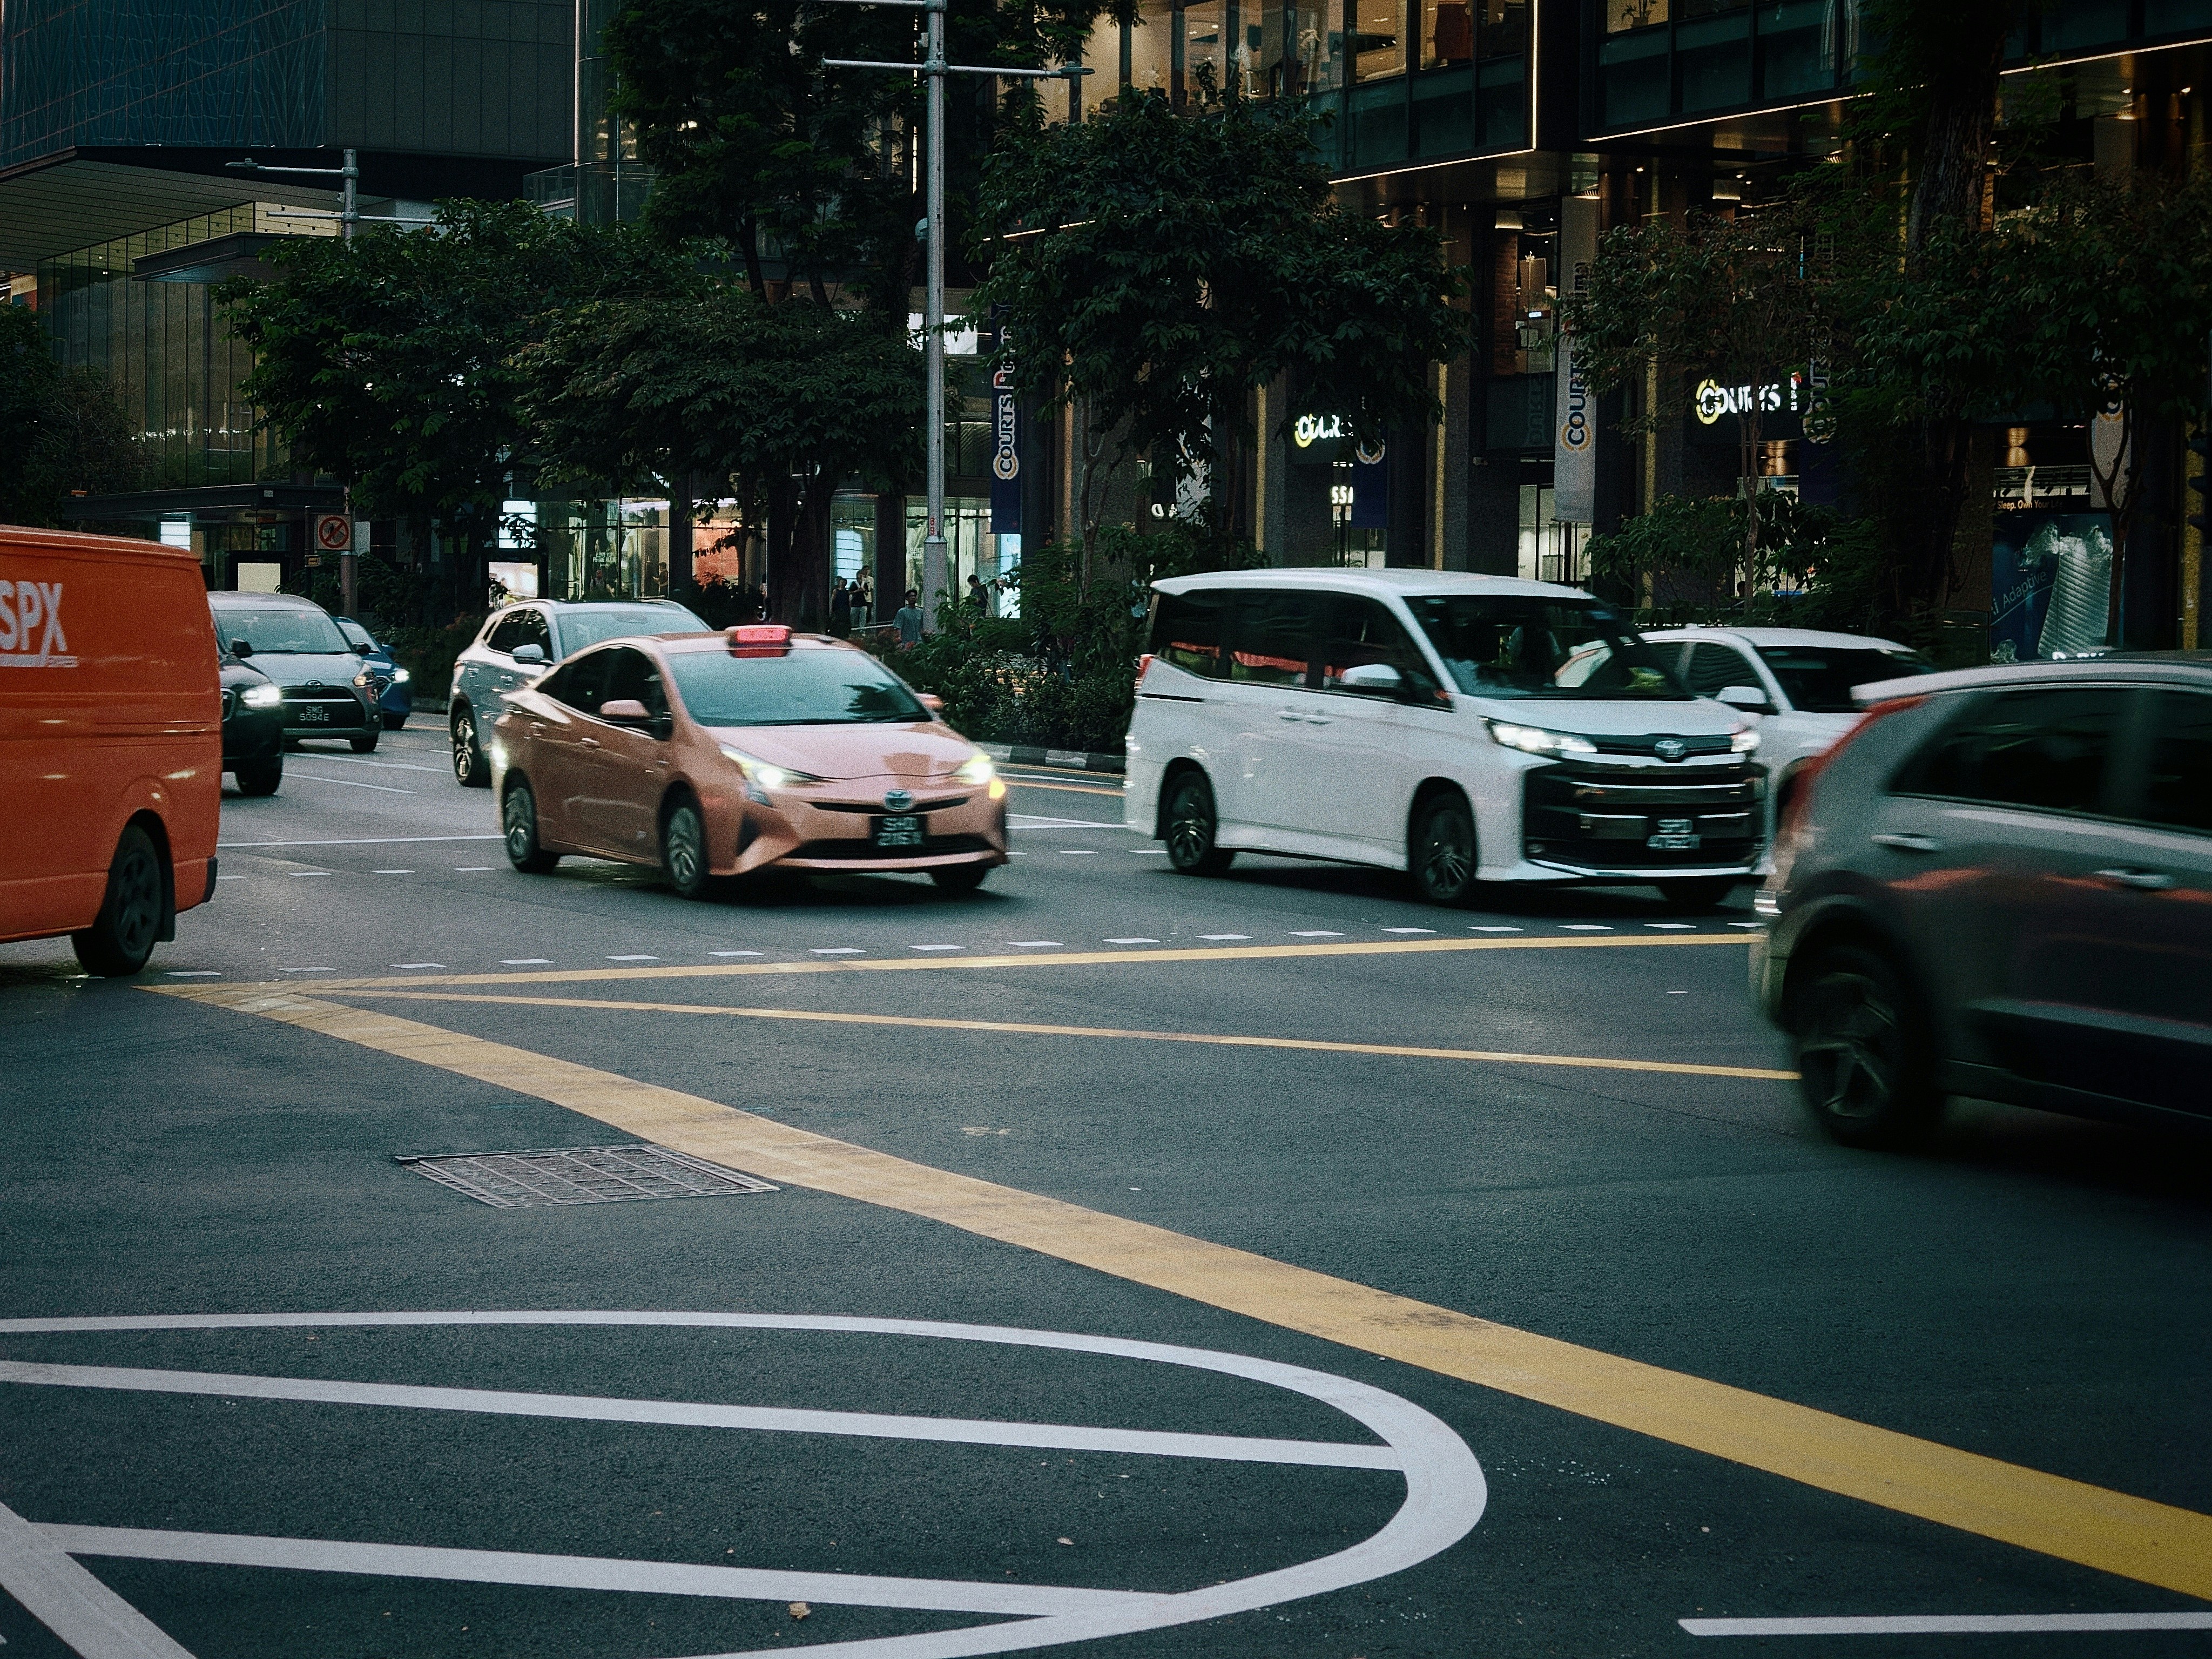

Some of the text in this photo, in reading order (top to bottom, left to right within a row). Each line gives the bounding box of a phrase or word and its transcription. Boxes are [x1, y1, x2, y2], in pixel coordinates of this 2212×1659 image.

[999, 394, 1015, 475] COURTS
[0, 579, 68, 657] SPX
[2002, 571, 2047, 609] Adaptive
